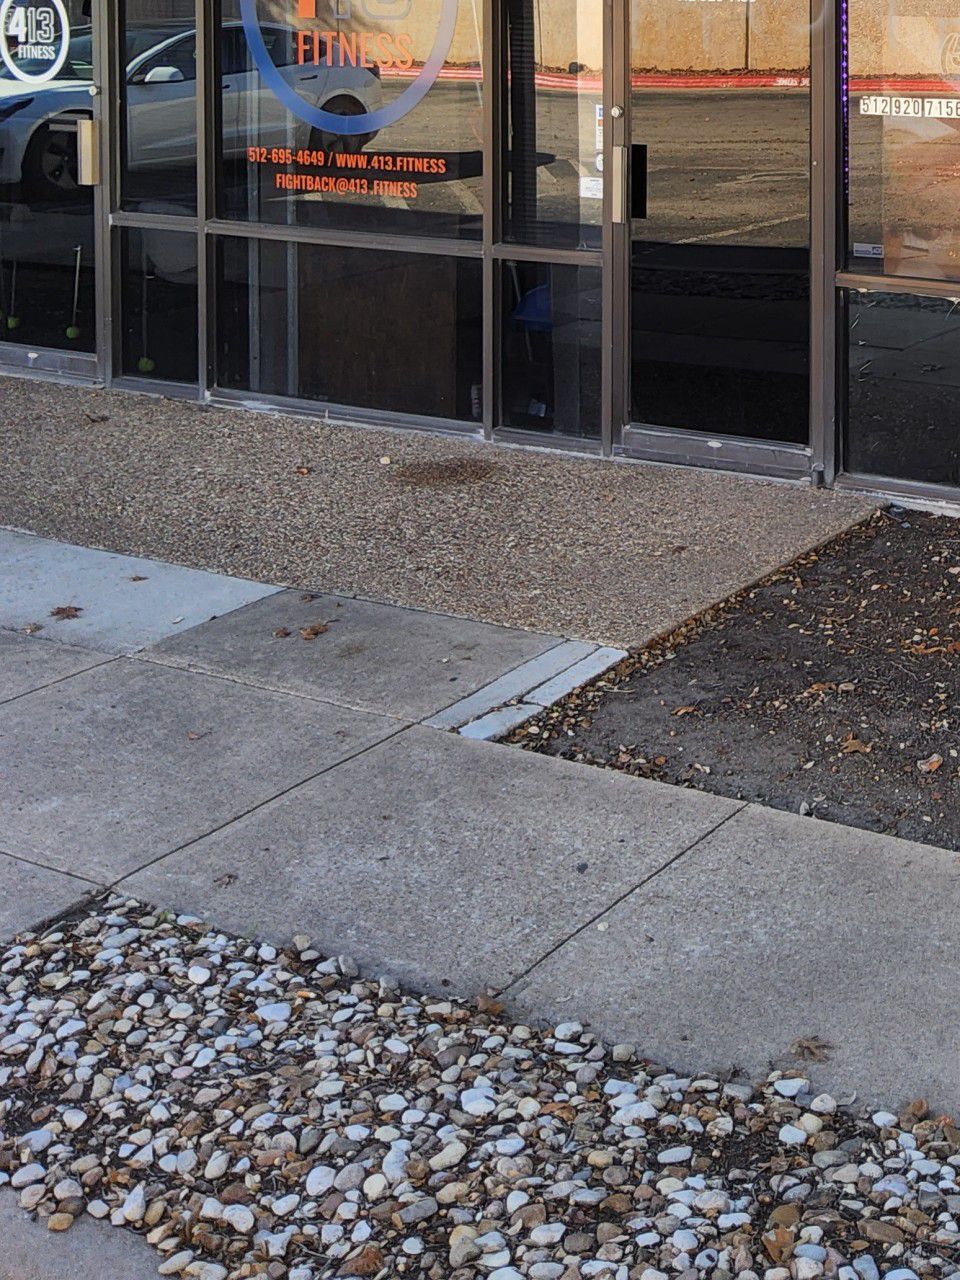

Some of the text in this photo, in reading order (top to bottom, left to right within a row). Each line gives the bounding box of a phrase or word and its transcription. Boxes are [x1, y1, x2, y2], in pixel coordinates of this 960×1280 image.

[9, 7, 54, 43] 413
[18, 45, 56, 60] FITNESS
[297, 31, 413, 70] FITNESS
[862, 97, 889, 114] 512
[894, 99, 920, 115] 920
[248, 147, 325, 166] 512-695-4649
[336, 153, 446, 174] WWW.413.FITNESS
